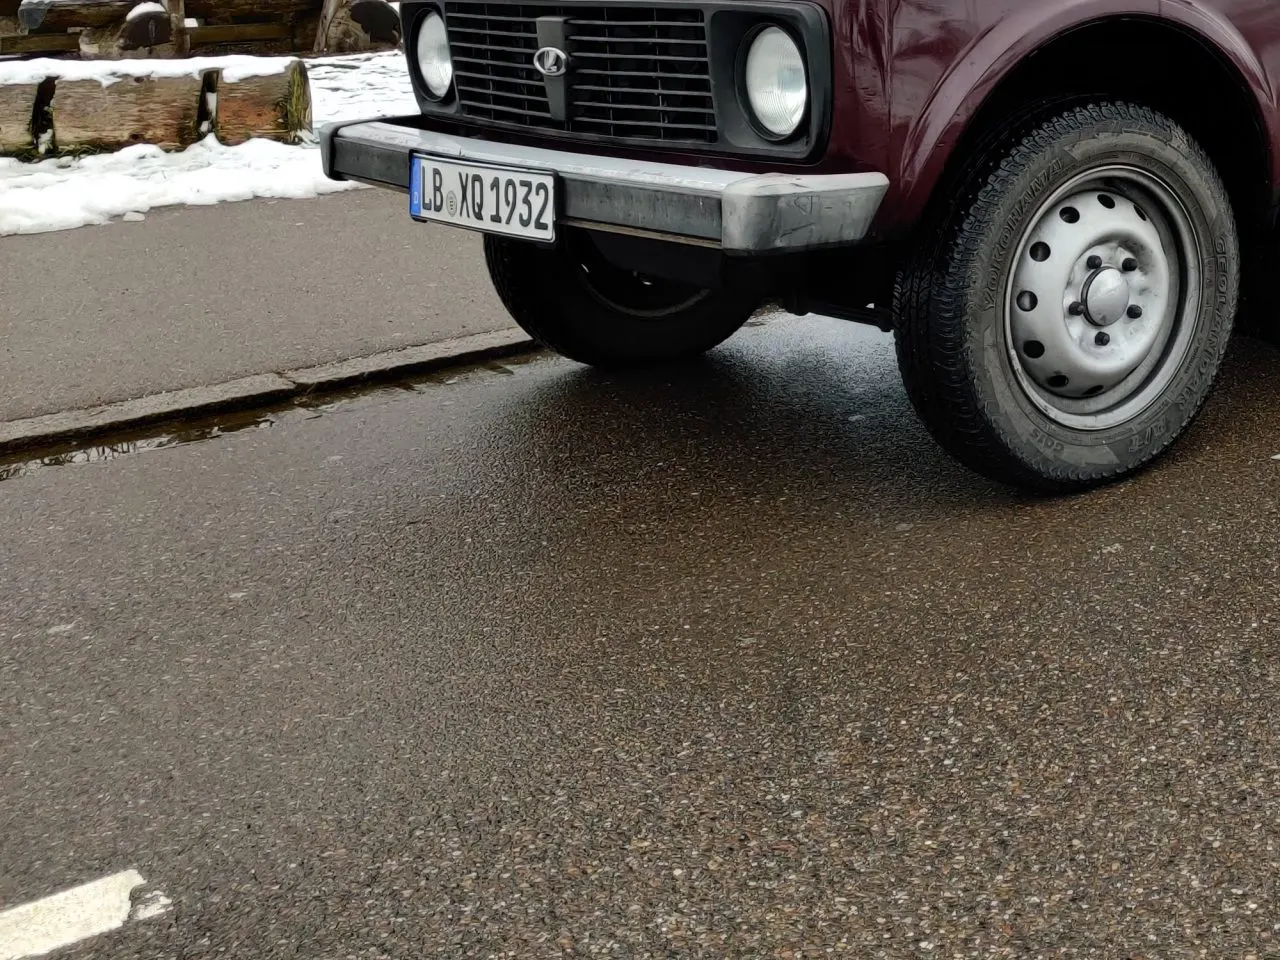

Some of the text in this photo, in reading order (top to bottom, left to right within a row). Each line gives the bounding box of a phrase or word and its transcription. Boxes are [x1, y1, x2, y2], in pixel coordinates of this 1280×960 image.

[421, 165, 549, 230] LB XQ 1932
[984, 157, 1063, 312] YOKOHAMA
